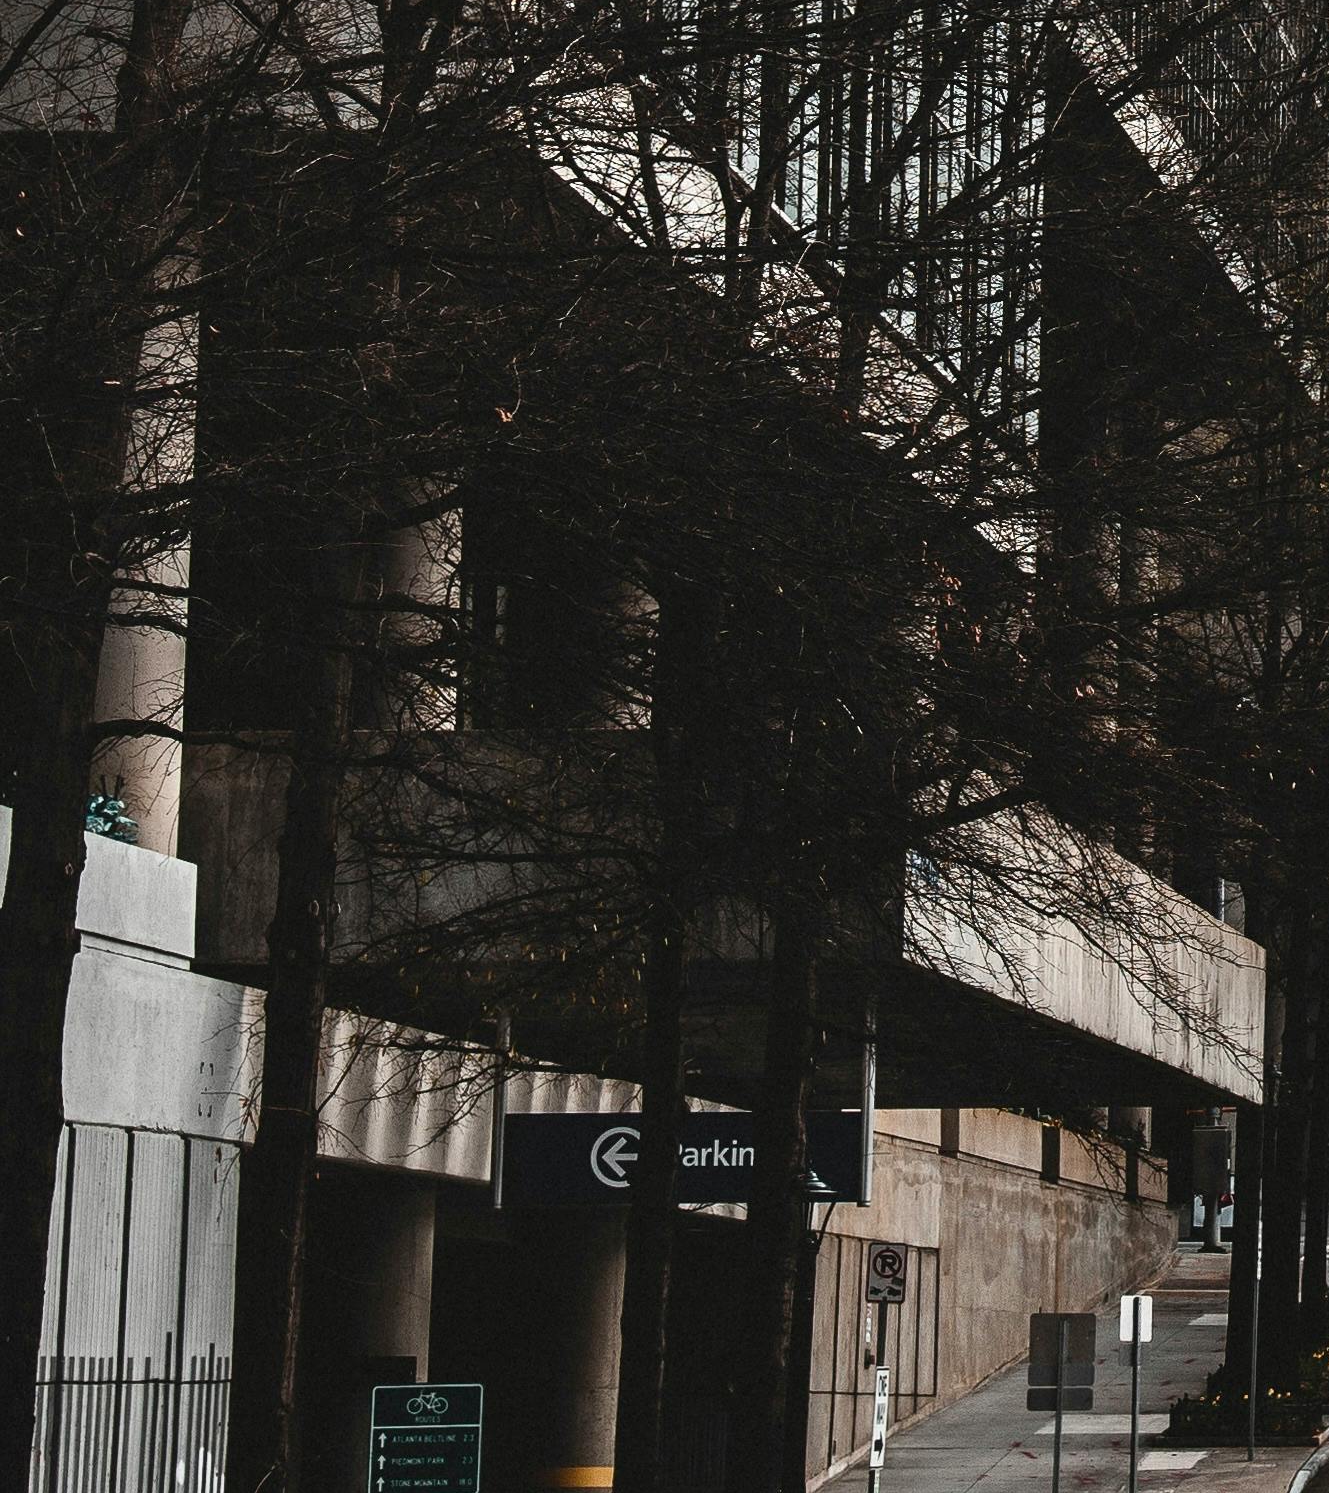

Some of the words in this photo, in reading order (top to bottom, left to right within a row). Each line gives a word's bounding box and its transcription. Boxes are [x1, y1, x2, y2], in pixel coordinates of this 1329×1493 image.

[679, 1139, 754, 1167] arkin
[392, 1435, 422, 1443] ATLANTA
[424, 1435, 457, 1443] BELTLINE
[414, 1479, 449, 1487] MOUNTAIN
